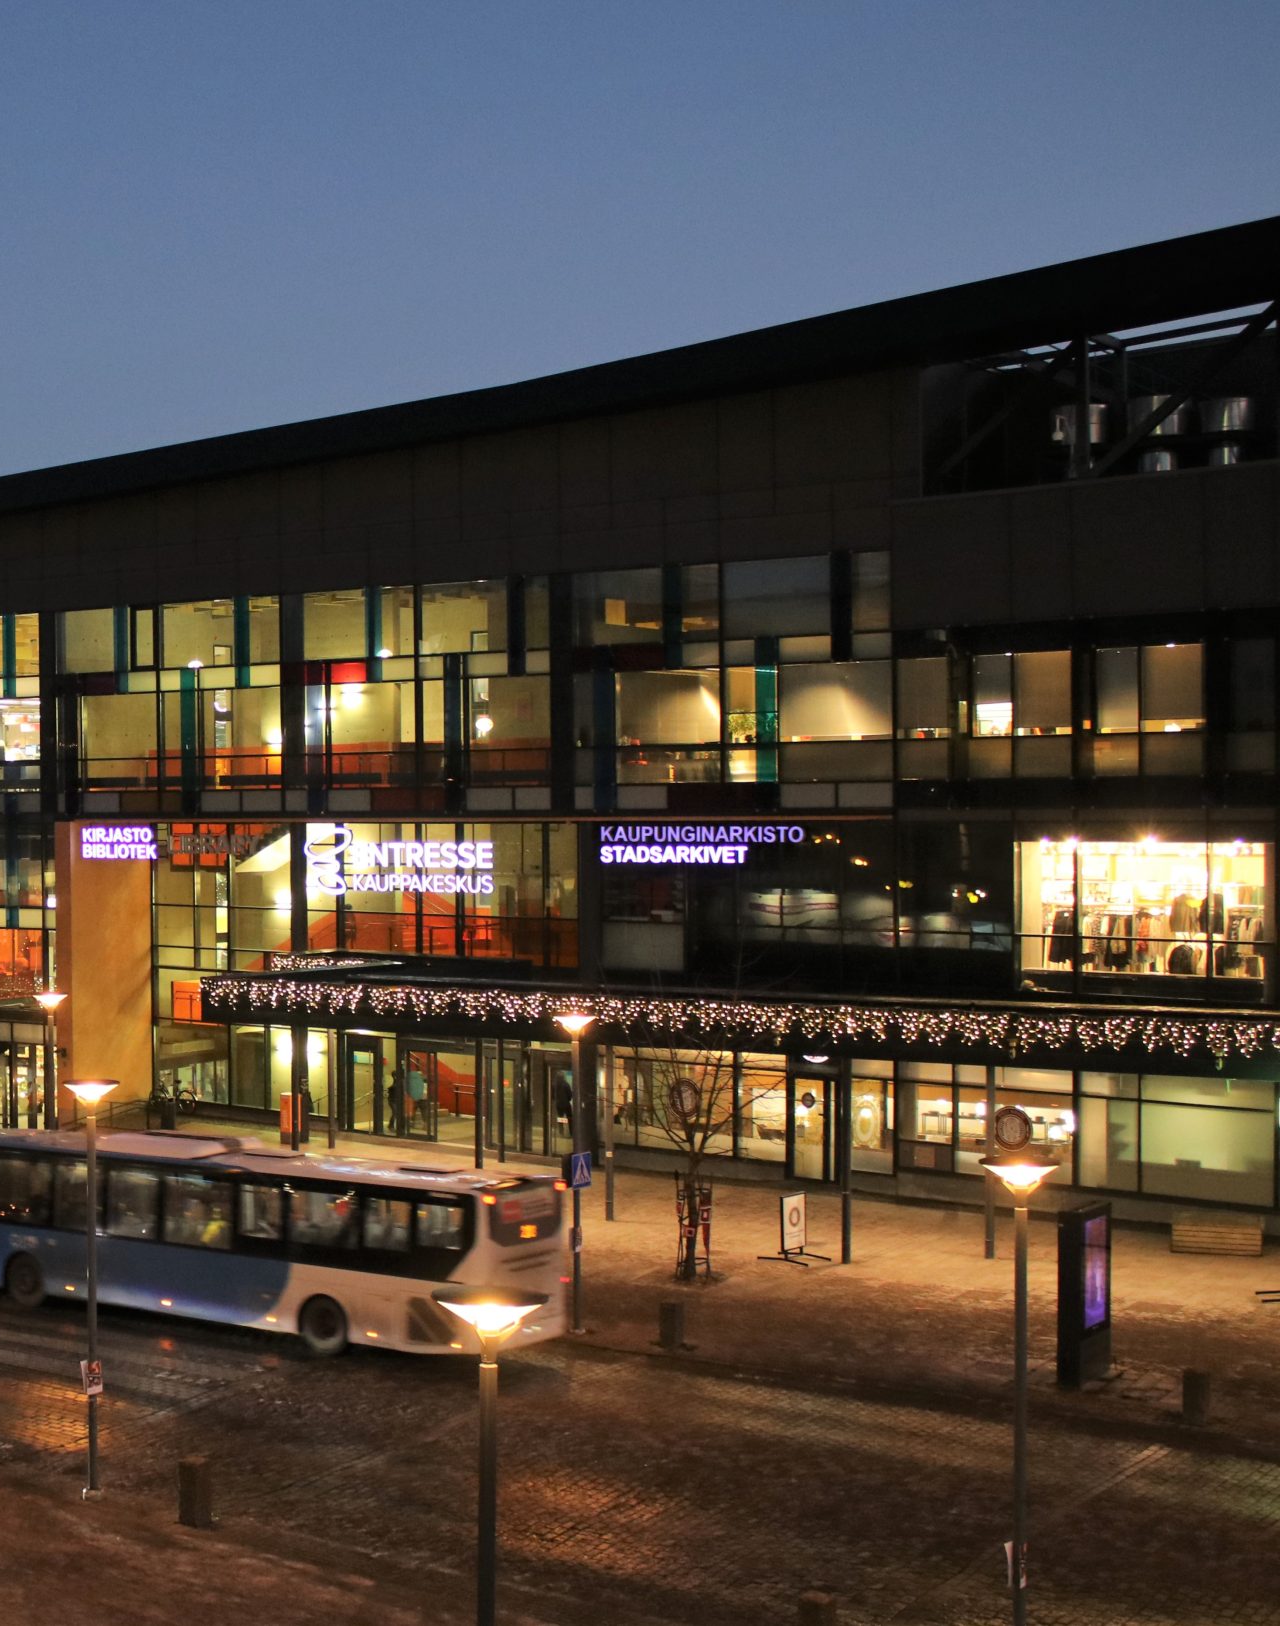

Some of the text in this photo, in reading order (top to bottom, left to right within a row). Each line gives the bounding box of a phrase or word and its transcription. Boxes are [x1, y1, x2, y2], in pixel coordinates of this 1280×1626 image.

[82, 827, 153, 843] KIRJASTO
[600, 826, 804, 843] KAUPUNGINARKISTO
[82, 844, 158, 859] BIBLIOTEK
[599, 845, 748, 863] STADSARKIVET
[352, 874, 494, 893] KAUPPAKESKUS
